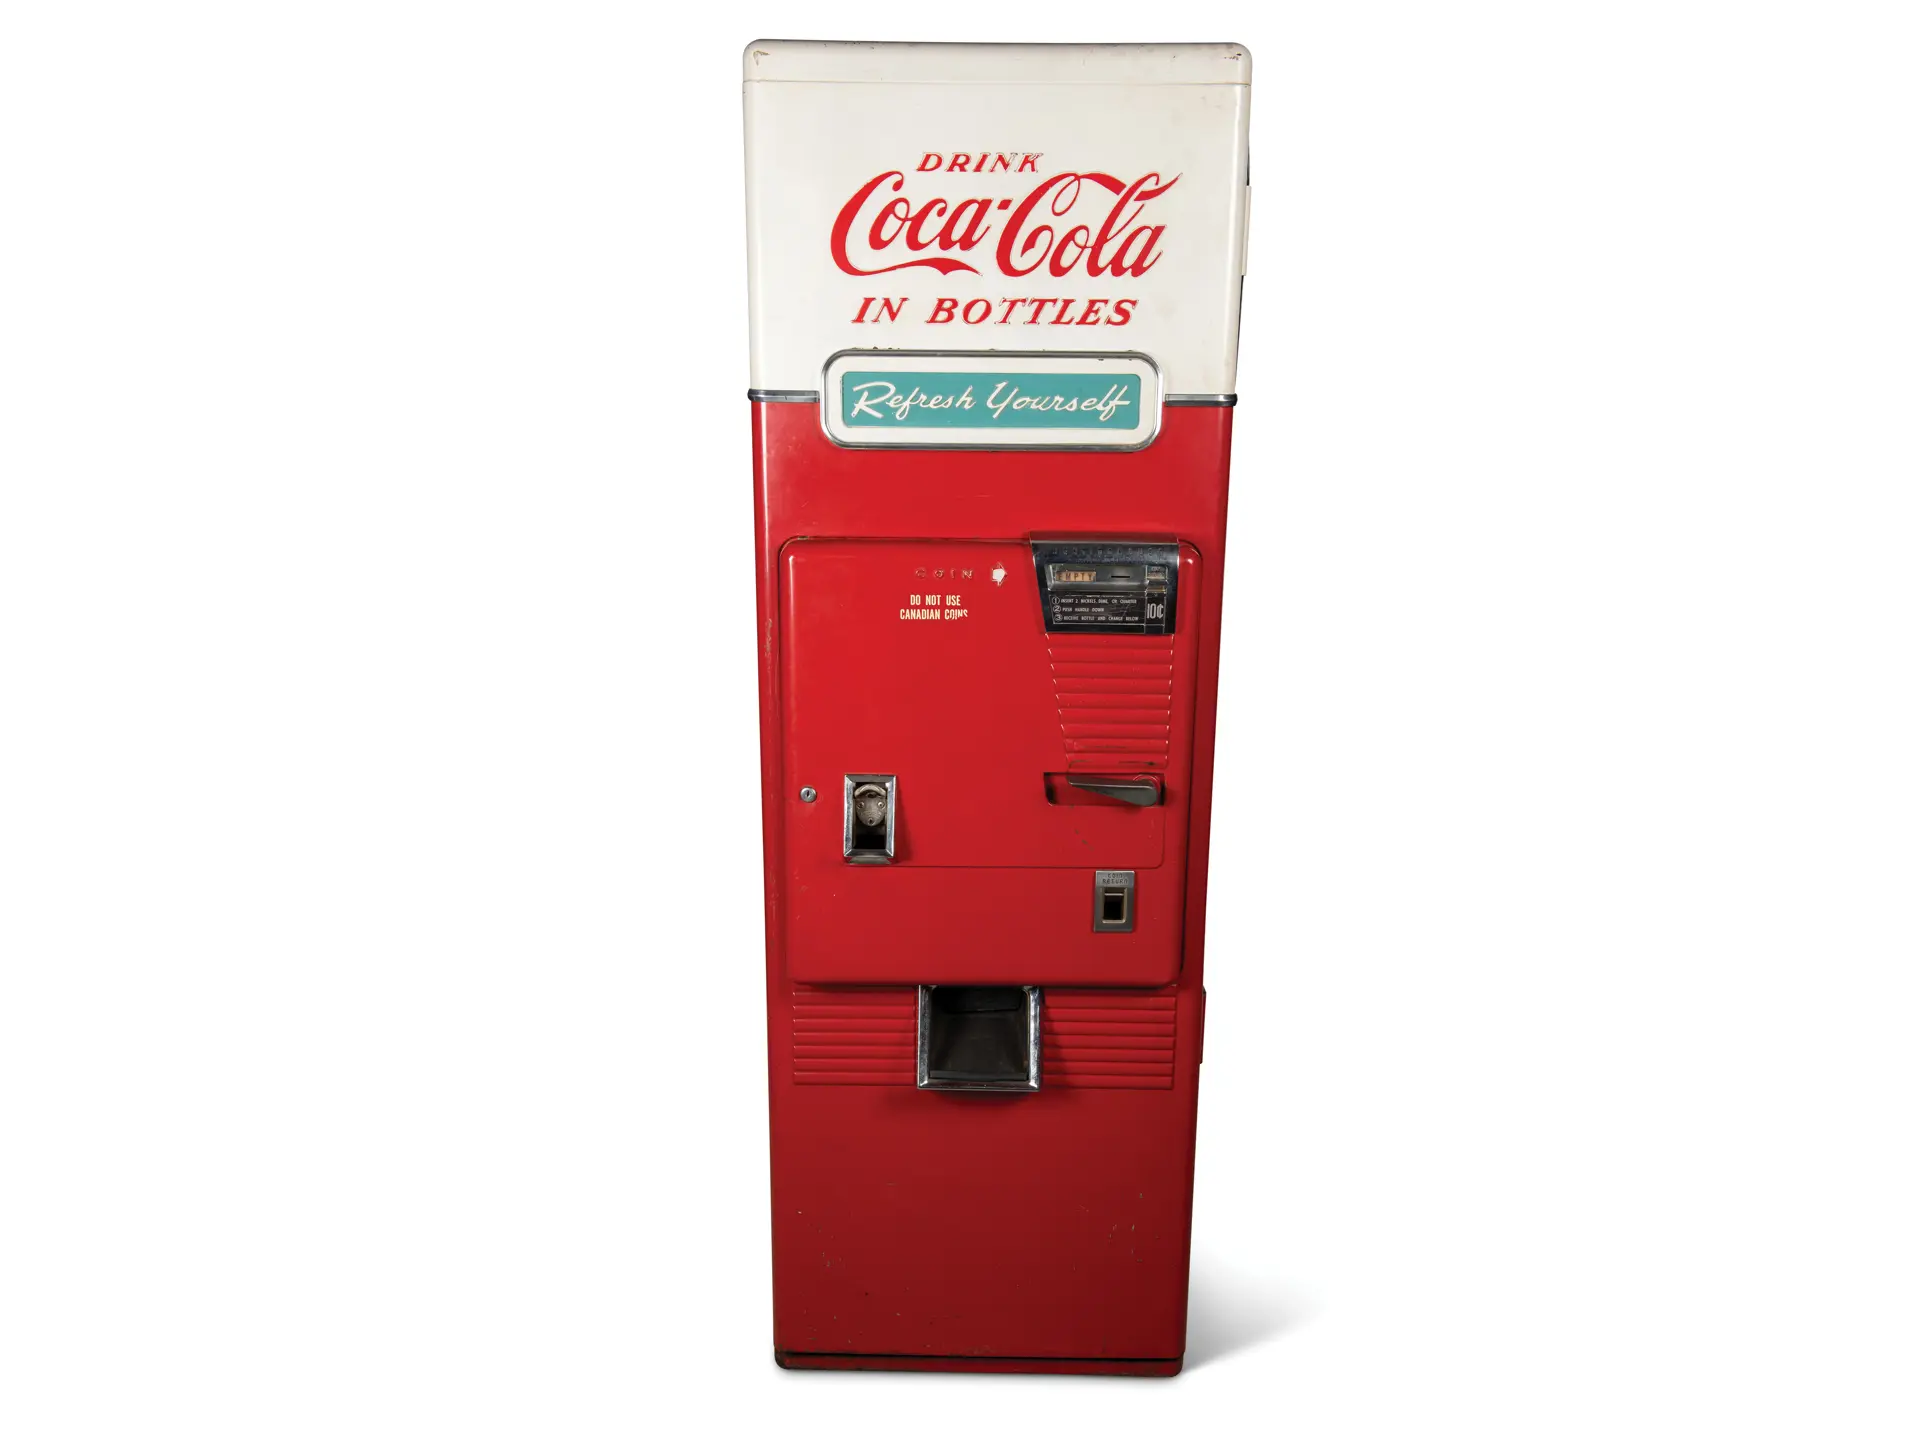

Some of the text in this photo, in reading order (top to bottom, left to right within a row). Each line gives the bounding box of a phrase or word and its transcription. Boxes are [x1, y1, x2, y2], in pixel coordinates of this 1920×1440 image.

[916, 152, 1043, 173] DRINK
[830, 170, 1183, 278] Coca-Cola
[852, 297, 1139, 326] IN BOTTLES
[851, 380, 1131, 421] Refresh Yourself
[1057, 572, 1093, 581] EMPTY
[910, 594, 961, 606] DO NOT USE
[900, 609, 968, 620] CANADIAN COINS
[1147, 603, 1164, 619] 10¢
